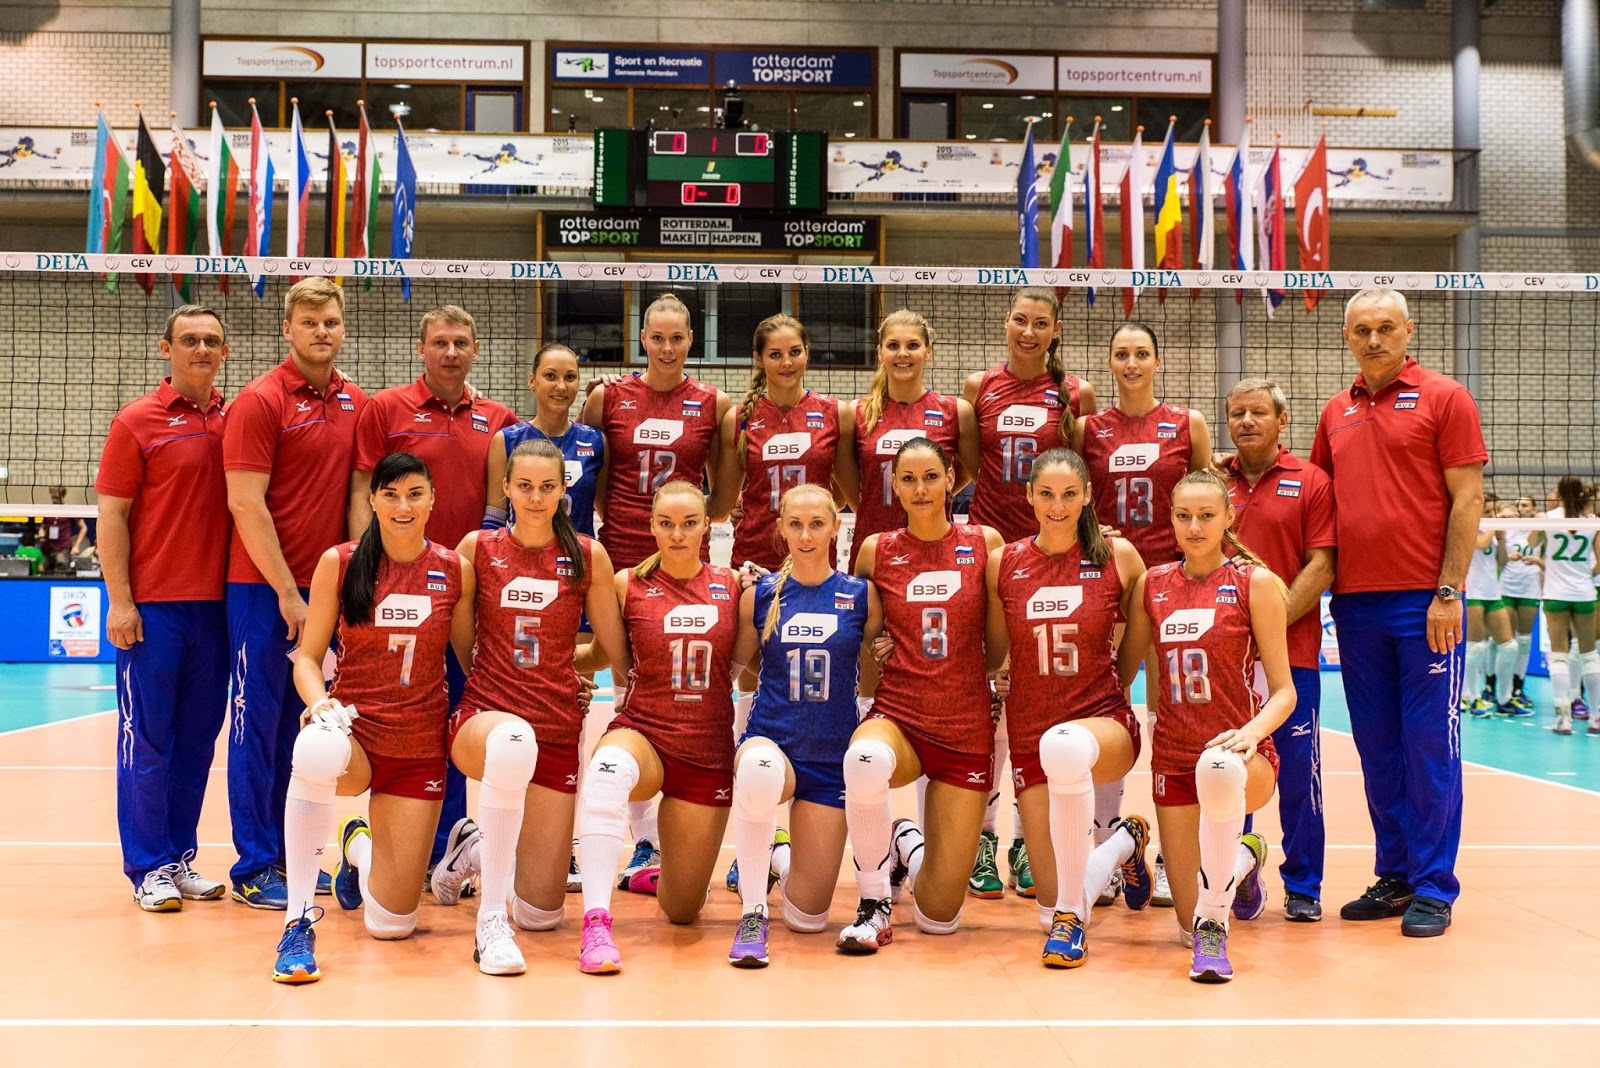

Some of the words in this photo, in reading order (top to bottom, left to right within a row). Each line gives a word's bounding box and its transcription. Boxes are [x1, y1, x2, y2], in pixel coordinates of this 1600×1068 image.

[374, 54, 514, 70] topsportcentrum.nl
[614, 55, 641, 67] Sport
[643, 57, 657, 66] en
[658, 56, 703, 67] Recreatie
[752, 54, 833, 68] rotterdam
[646, 69, 679, 77] Rotterdam
[752, 69, 833, 83] TOPSPORT
[1066, 68, 1201, 83] topsportcentrum.nl
[552, 138, 569, 146] 2015
[560, 217, 639, 230] rotterdam
[662, 219, 731, 230] ROTTERDAM.
[784, 219, 864, 234] rotterdam
[560, 230, 639, 244] TOPSPORT
[662, 233, 693, 244] MAKE
[698, 233, 708, 244] IT
[711, 234, 760, 245] HAPPEN.
[784, 234, 863, 247] TOPSPORT
[36, 254, 89, 271] DELA
[131, 258, 153, 268] CEV
[195, 257, 248, 274] DELA
[289, 261, 312, 271] CEV
[353, 259, 406, 276] DELA
[447, 264, 469, 274] CEV
[510, 262, 563, 279] DELA
[603, 266, 626, 276] CEV
[667, 265, 719, 281] DELA
[759, 268, 782, 278] CEV
[822, 267, 875, 283] DELA
[915, 271, 937, 280] CEV
[977, 269, 1029, 285] DELA
[1069, 272, 1091, 282] CEV
[1131, 270, 1182, 287] DELA
[1222, 274, 1243, 284] CEV
[1284, 272, 1334, 288] DELA
[1374, 275, 1395, 285] CEV
[1435, 274, 1485, 289] DELA
[1524, 277, 1545, 286] CEV
[1003, 416, 1035, 427] ВЭБ
[639, 429, 671, 440] ВЭБ
[768, 443, 800, 455] ВЭБ
[881, 439, 907, 450] ВЭ
[1000, 436, 1037, 484] 16
[1114, 454, 1147, 466] ВЭБ
[638, 449, 676, 495] 12
[1114, 477, 1154, 525] 13
[1551, 533, 1589, 562] 22
[430, 583, 445, 591] RUS
[913, 584, 948, 596] ВЭБ
[507, 589, 544, 604] ВЭБ
[1032, 600, 1069, 612] ВЭБ
[381, 608, 419, 621] ВЭБ
[670, 616, 706, 628] ВЭБ
[1165, 622, 1199, 636] ВЭБ
[787, 625, 824, 637] ВЭБ
[921, 607, 948, 660] 8
[513, 615, 542, 668] 5
[1033, 623, 1079, 677] 15
[388, 634, 417, 686] 7
[669, 638, 713, 691] 10
[786, 647, 831, 703] 19
[1166, 647, 1211, 705] 18
